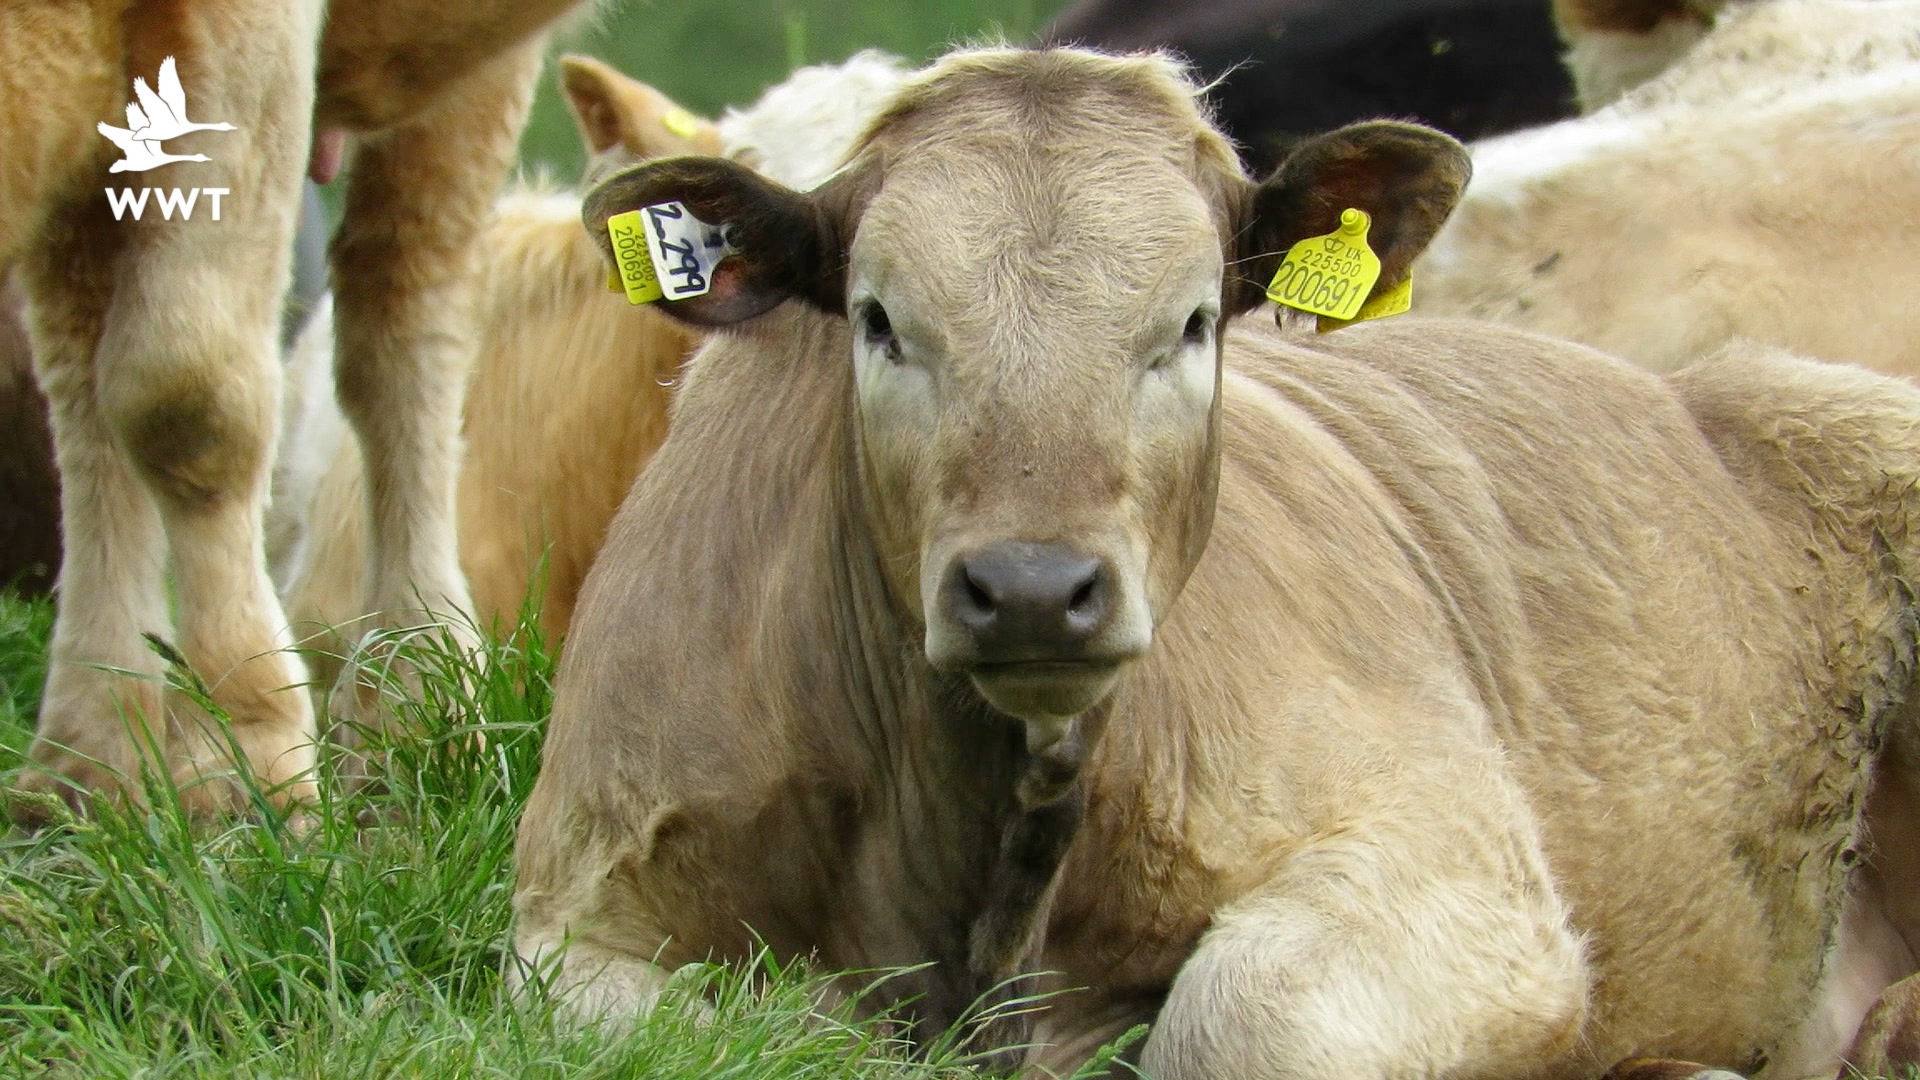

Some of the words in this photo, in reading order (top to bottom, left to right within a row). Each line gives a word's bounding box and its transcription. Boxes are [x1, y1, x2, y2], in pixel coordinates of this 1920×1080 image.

[615, 226, 647, 290] 200691
[1301, 249, 1362, 277] 225500
[1346, 248, 1364, 261] UK
[1267, 260, 1362, 315] 200691
